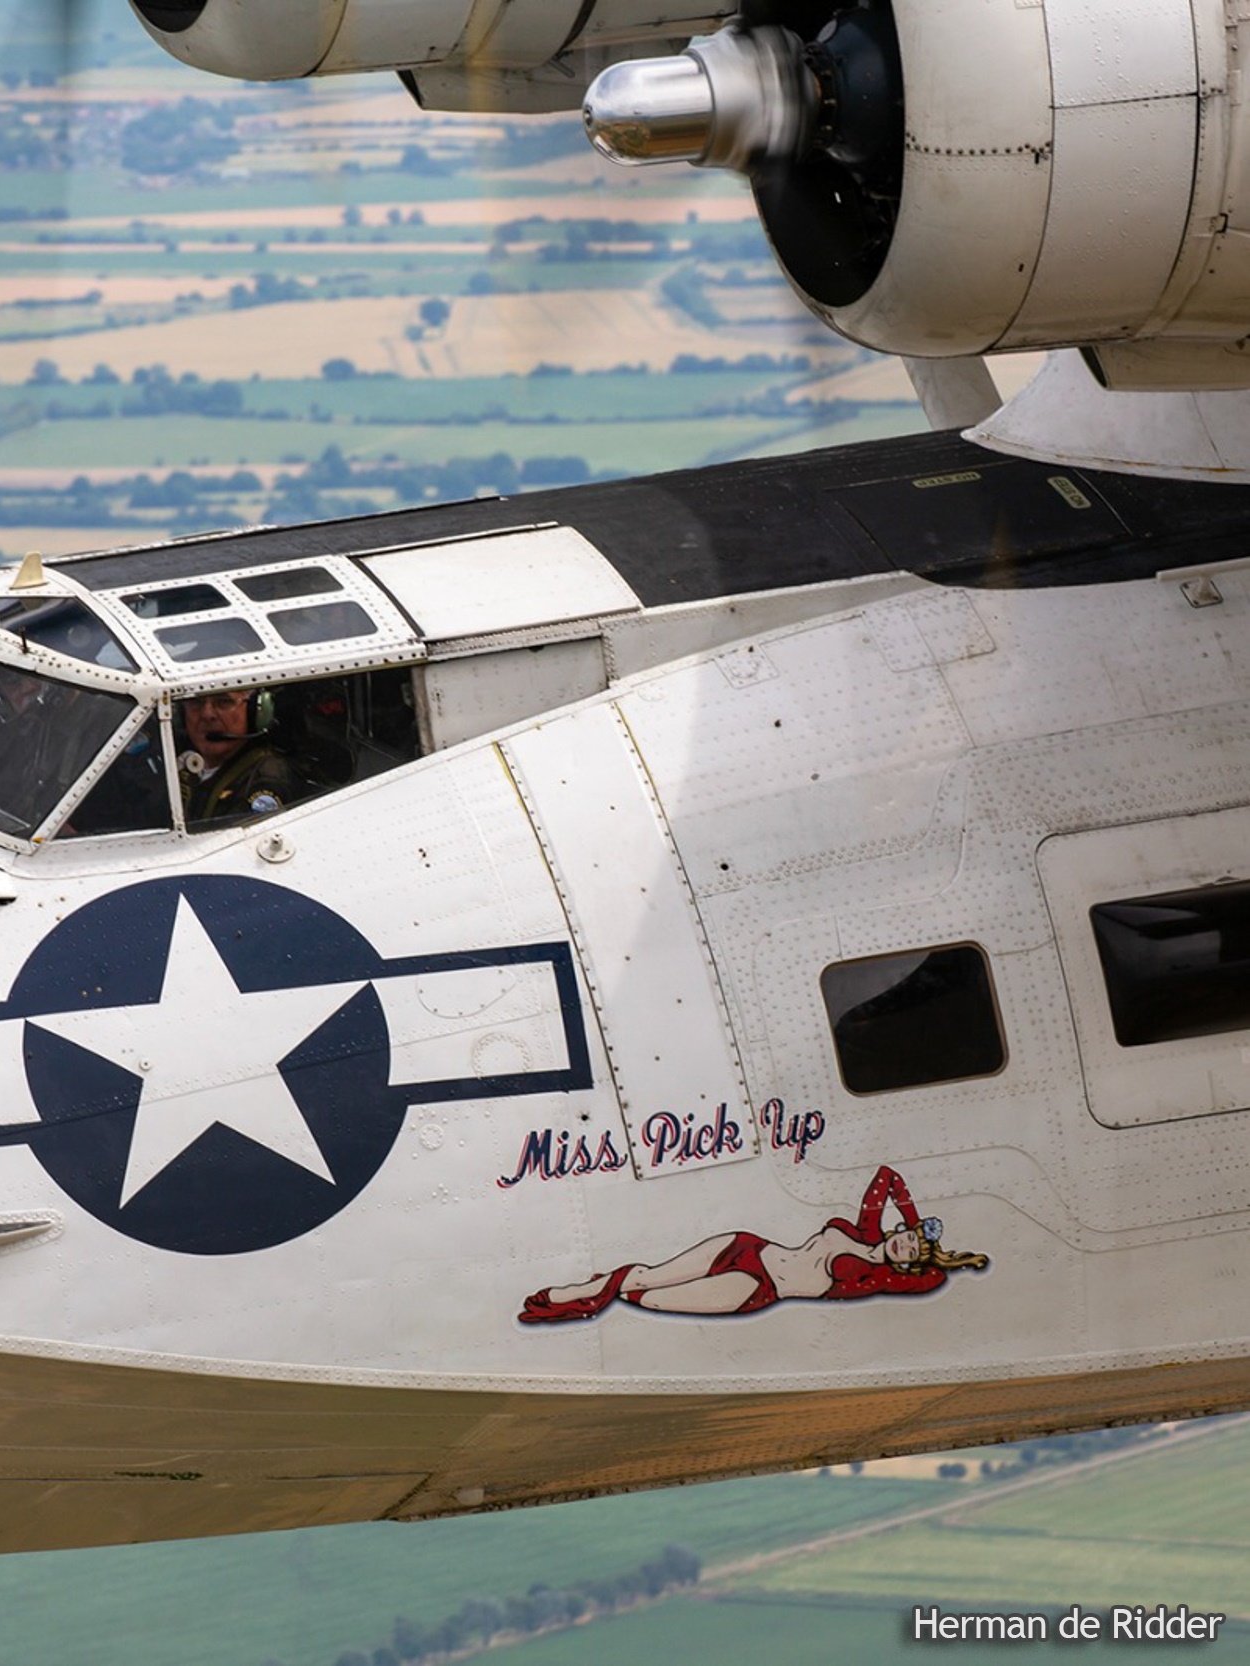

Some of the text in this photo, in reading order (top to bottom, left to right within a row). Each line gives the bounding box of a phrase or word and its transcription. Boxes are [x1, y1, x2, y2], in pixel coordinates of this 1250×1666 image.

[497, 1098, 826, 1188] Miss Pick Up
